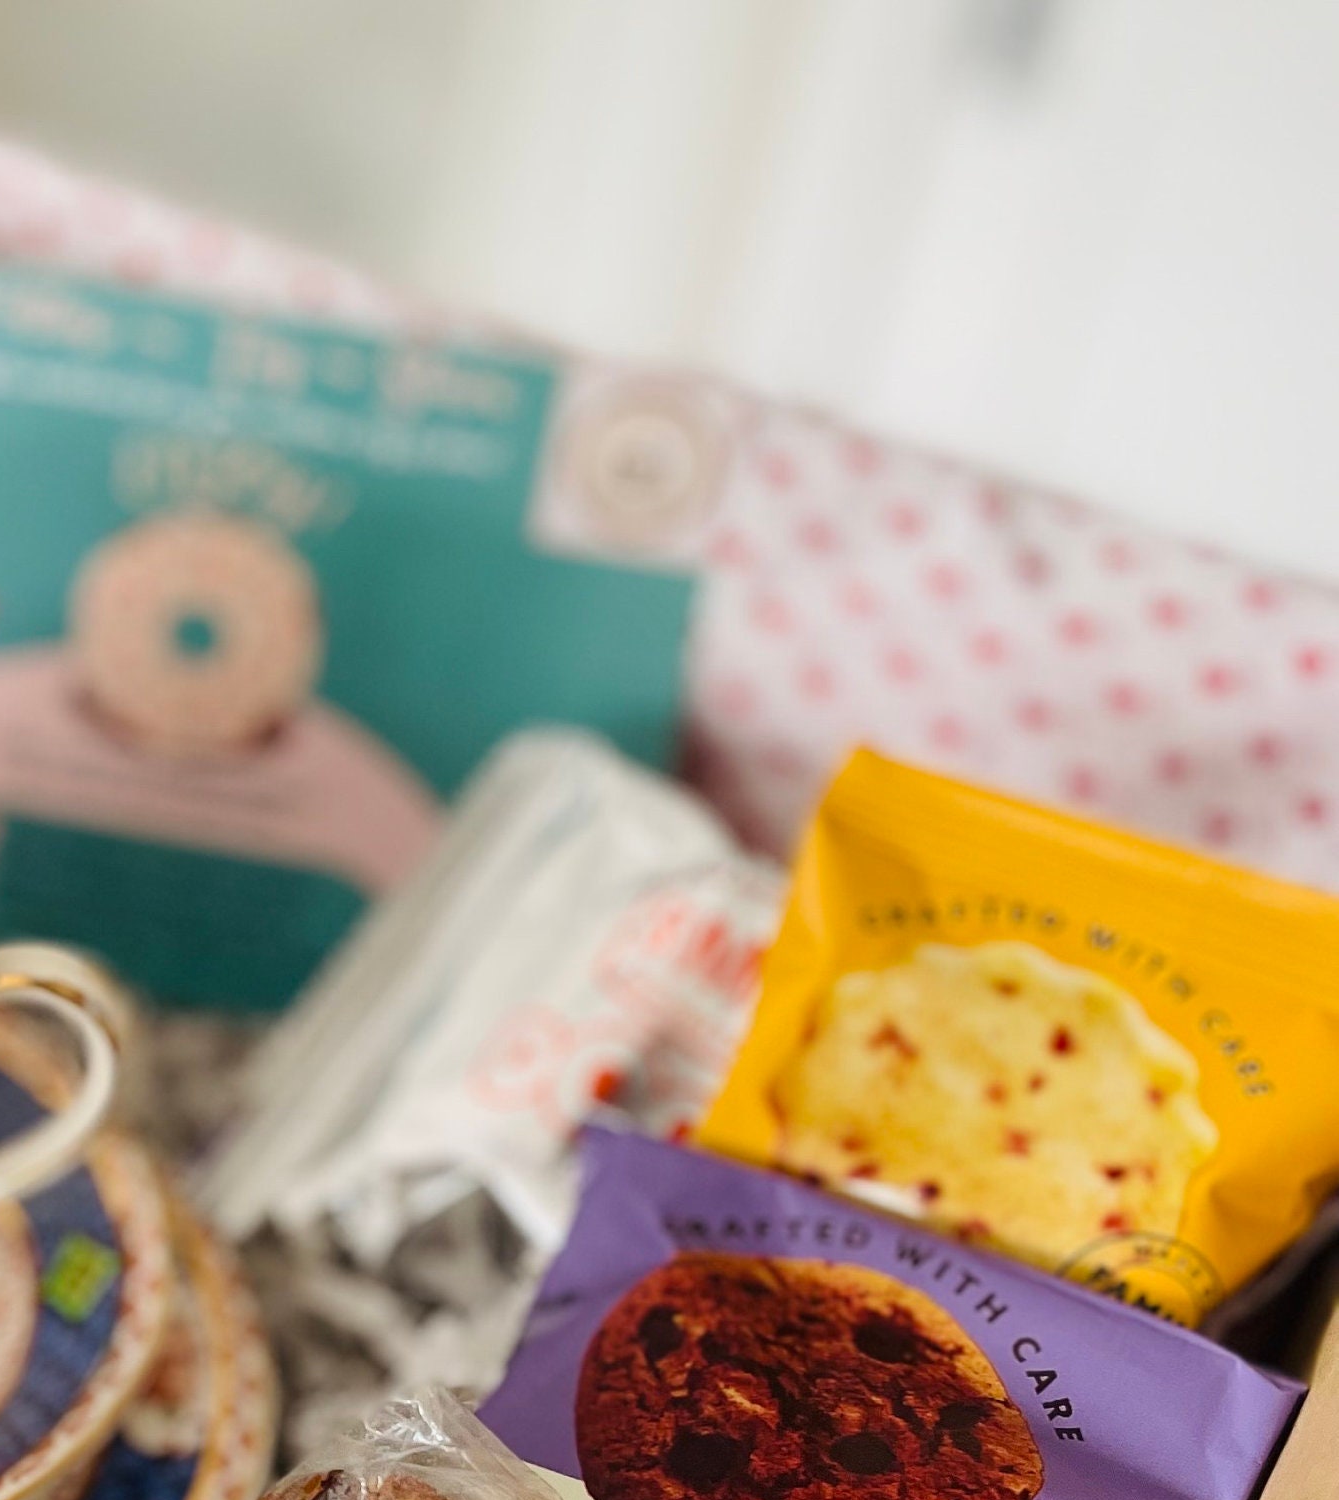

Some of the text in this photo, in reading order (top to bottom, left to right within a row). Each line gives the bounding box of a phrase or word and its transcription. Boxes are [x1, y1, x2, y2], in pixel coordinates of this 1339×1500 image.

[663, 1212, 1085, 1444] CRAFTED WITH CARE
